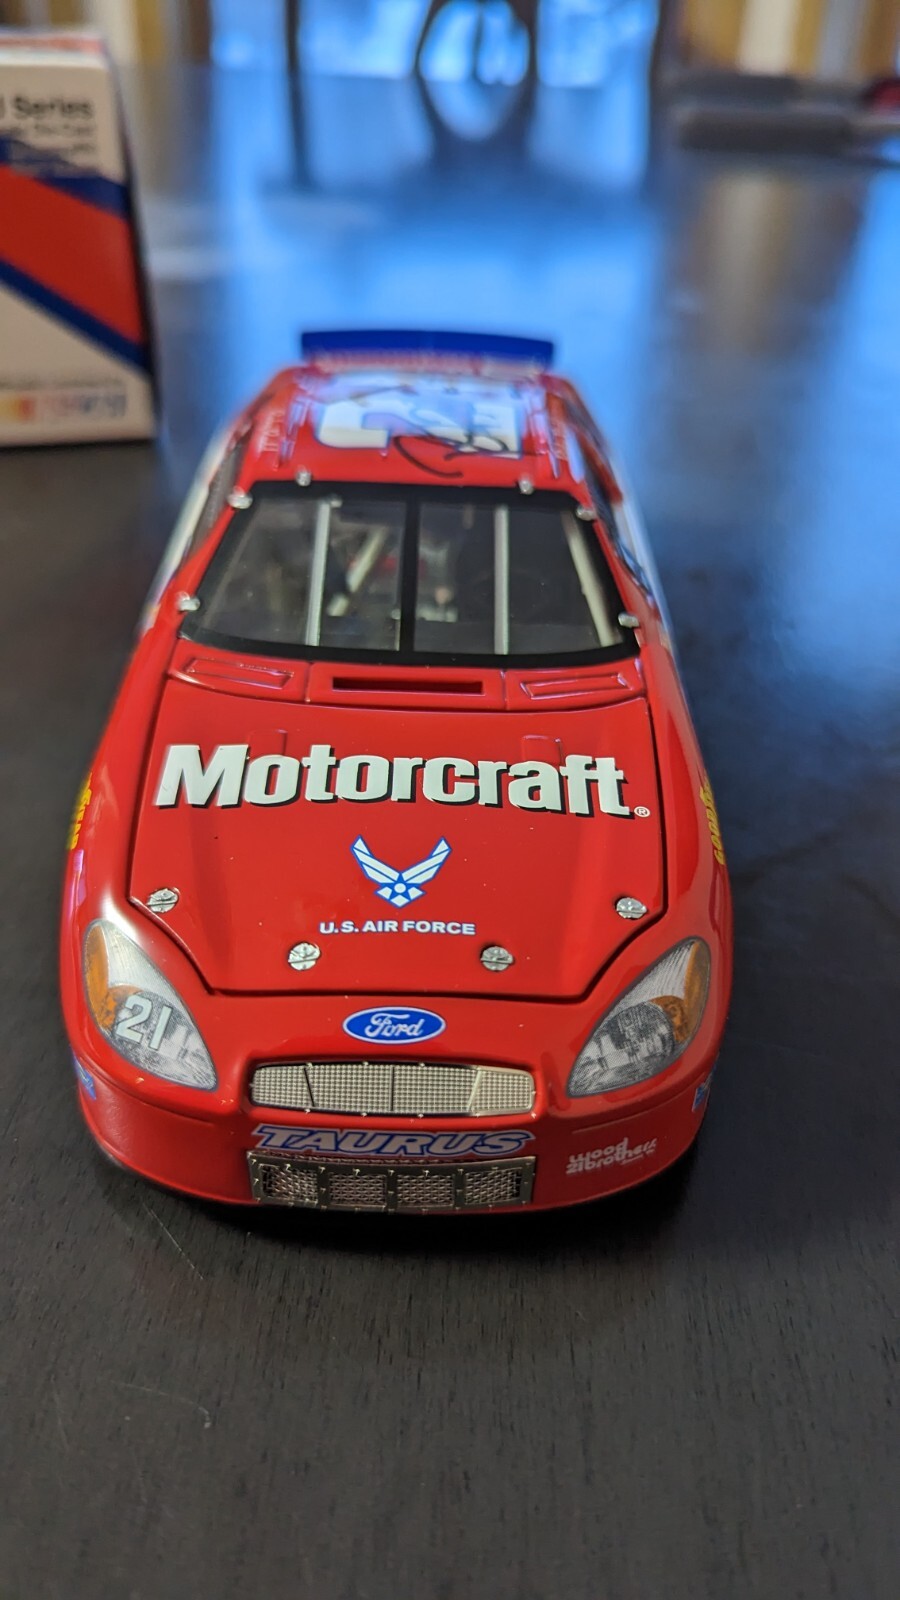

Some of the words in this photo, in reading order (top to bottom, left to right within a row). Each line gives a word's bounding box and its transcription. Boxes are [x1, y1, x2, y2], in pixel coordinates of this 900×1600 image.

[155, 743, 635, 819] Motorcraft
[319, 921, 360, 934] U.S.
[362, 920, 398, 933] AIR
[402, 920, 476, 935] FORCE
[115, 993, 174, 1052] 21
[364, 1012, 425, 1038] Ford
[250, 1123, 536, 1157] TAURUS
